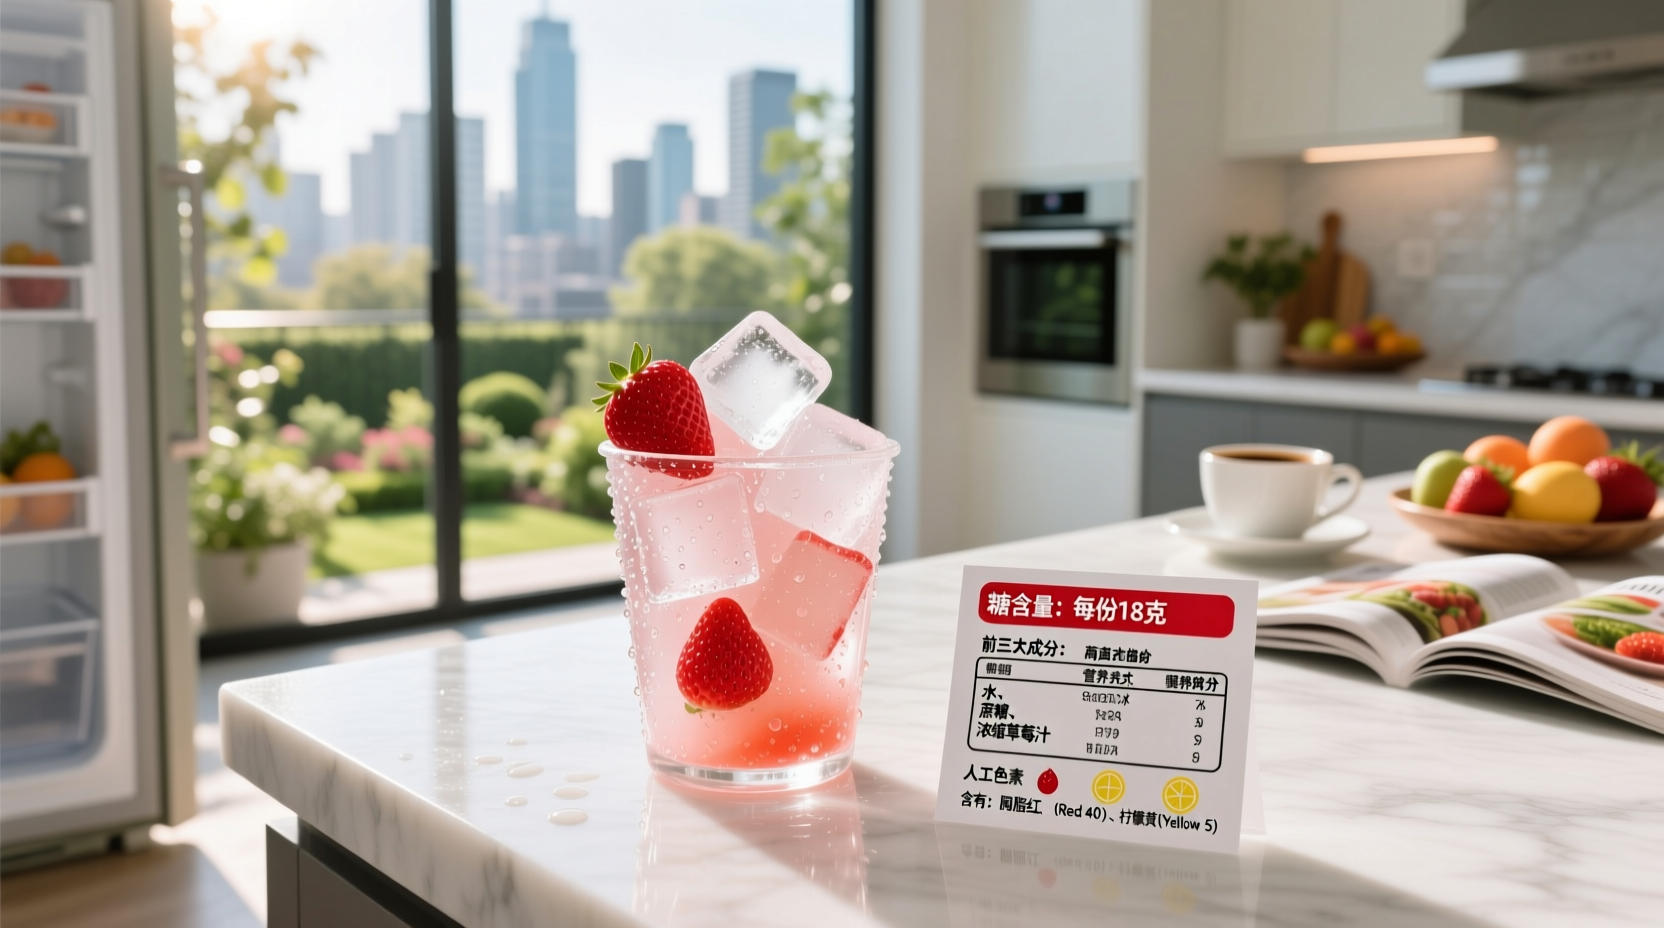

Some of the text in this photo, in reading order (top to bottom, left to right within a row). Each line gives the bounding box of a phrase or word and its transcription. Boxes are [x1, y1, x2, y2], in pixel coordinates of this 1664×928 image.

[981, 635, 1066, 658] 前三大成分：
[963, 764, 1024, 786] 人工色素
[1055, 803, 1082, 818] (Red
[1205, 819, 1218, 836] 5)
